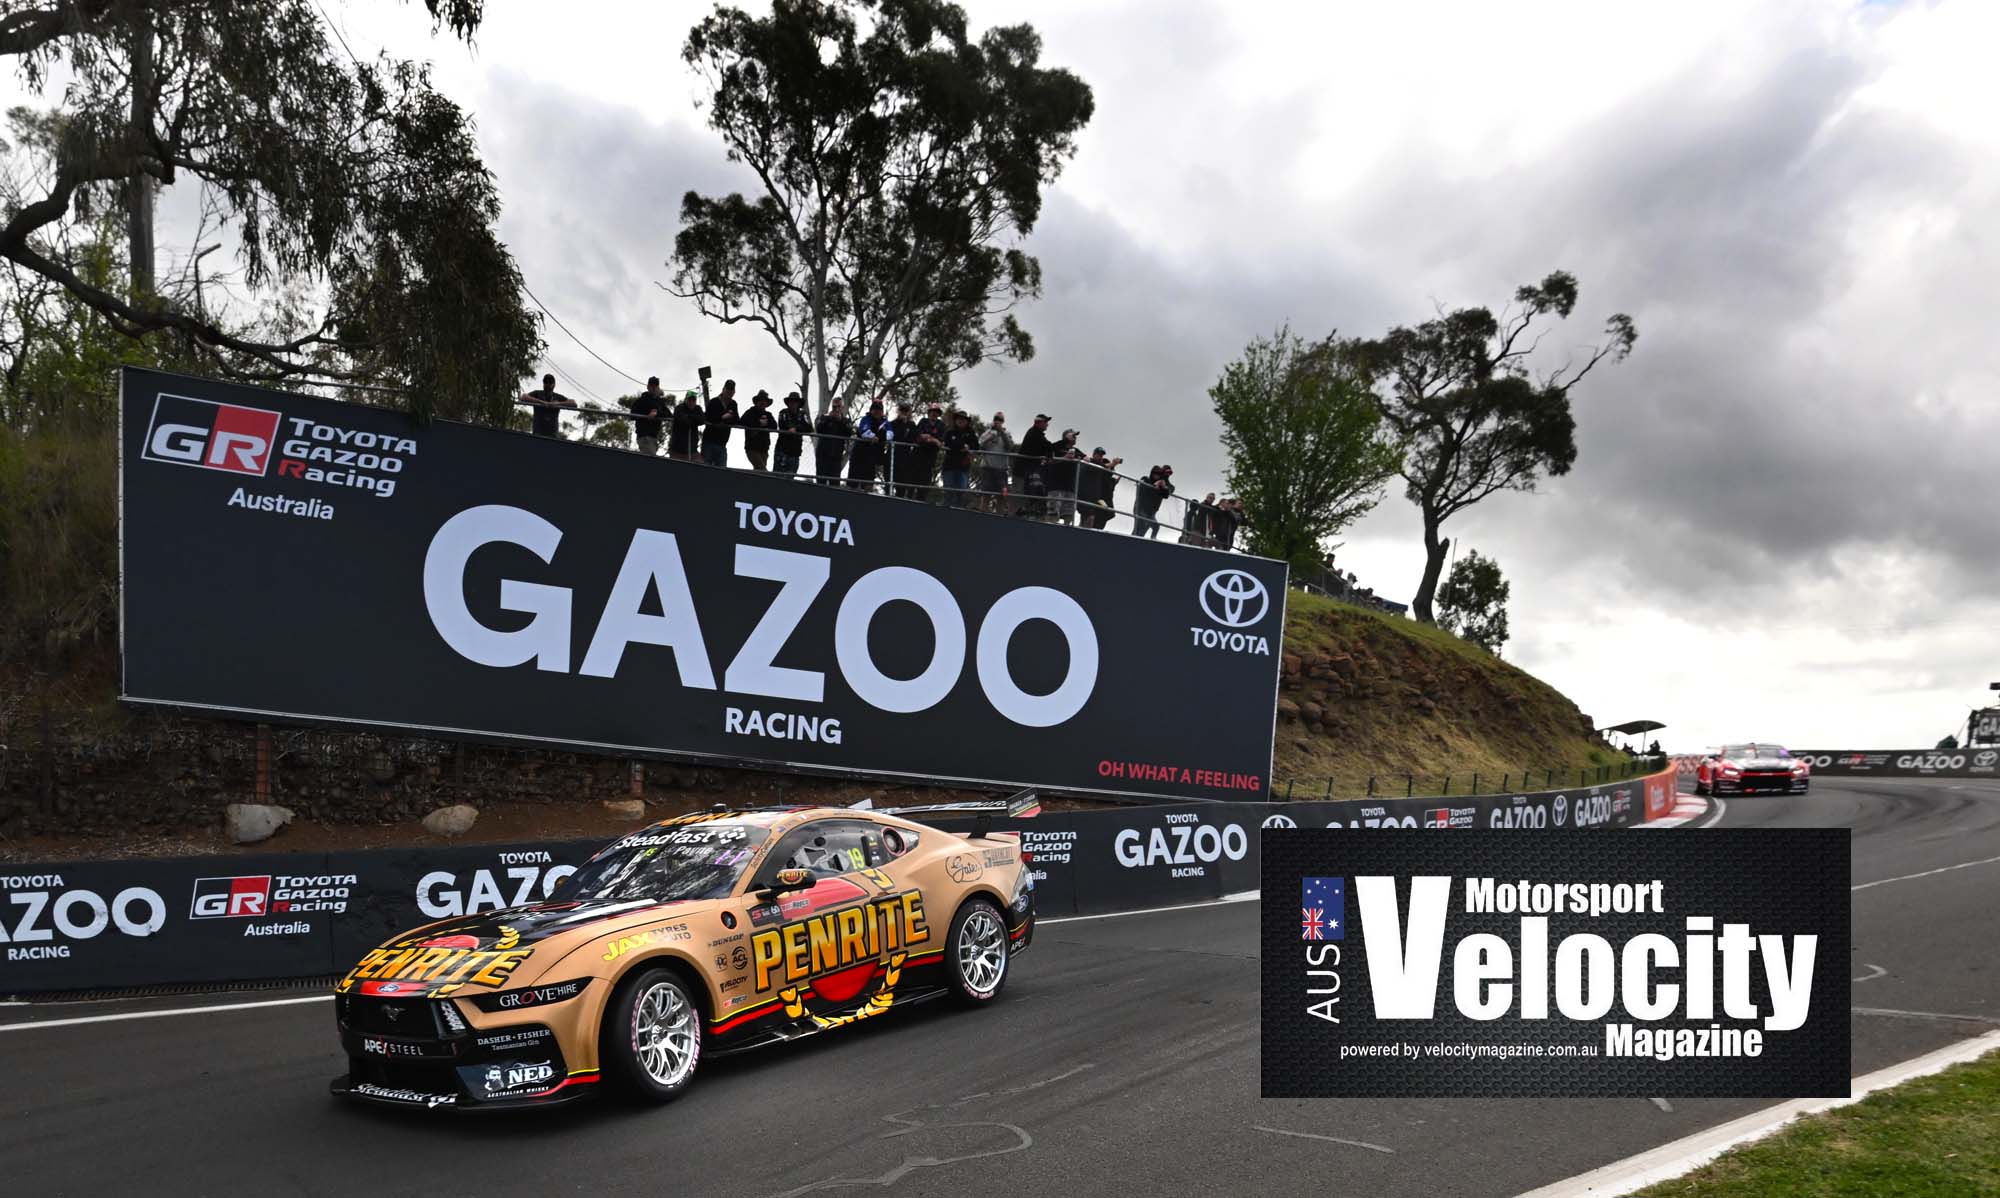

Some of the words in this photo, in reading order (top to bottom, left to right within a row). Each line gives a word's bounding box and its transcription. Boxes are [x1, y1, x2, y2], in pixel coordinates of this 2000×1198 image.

[151, 423, 267, 471] GR
[289, 417, 417, 455] TOYOTA
[283, 440, 403, 473] GAZOO
[278, 459, 396, 497] Racing
[227, 488, 335, 520] Australia
[734, 501, 855, 546] TOYOTA
[423, 504, 1099, 727] GAZOO
[1190, 626, 1270, 656] TOYOTA
[724, 706, 842, 745] RACING
[1896, 755, 1966, 769] GAZOO
[1098, 760, 1125, 778] OH
[1128, 762, 1178, 783] WHAT
[1179, 769, 1192, 784] A
[1195, 770, 1261, 791] FEELING
[1165, 813, 1200, 824] TOYOTA
[1361, 807, 1387, 817] TOYOTA
[1574, 795, 1612, 827] GAZOO
[615, 826, 718, 850] Steadfast
[1022, 831, 1078, 842] TOYOTA
[1022, 842, 1073, 852] GAZOO
[1114, 823, 1248, 868] GAZOO
[498, 851, 552, 865] TOYOTA
[847, 847, 866, 870] 19
[0, 874, 65, 889] TOYOTA
[275, 875, 357, 888] TOYOTA
[1171, 867, 1205, 878] RACING
[194, 892, 265, 916] GR
[274, 888, 349, 900] GAZOO
[272, 900, 347, 914] Racing
[244, 921, 311, 937] Australia
[8, 945, 71, 961] RACING
[602, 931, 653, 962] JAX
[650, 923, 688, 935] TYRES
[751, 890, 929, 993] PENRITE
[354, 948, 533, 987] PENRITE
[499, 988, 558, 1008] GROVE
[557, 983, 577, 996] HIRE
[477, 1034, 516, 1046] DASHER
[517, 1029, 551, 1041] FISHER
[492, 1042, 527, 1051] Tasmanian
[389, 1043, 424, 1056] STEEL
[508, 1065, 553, 1084] NED
